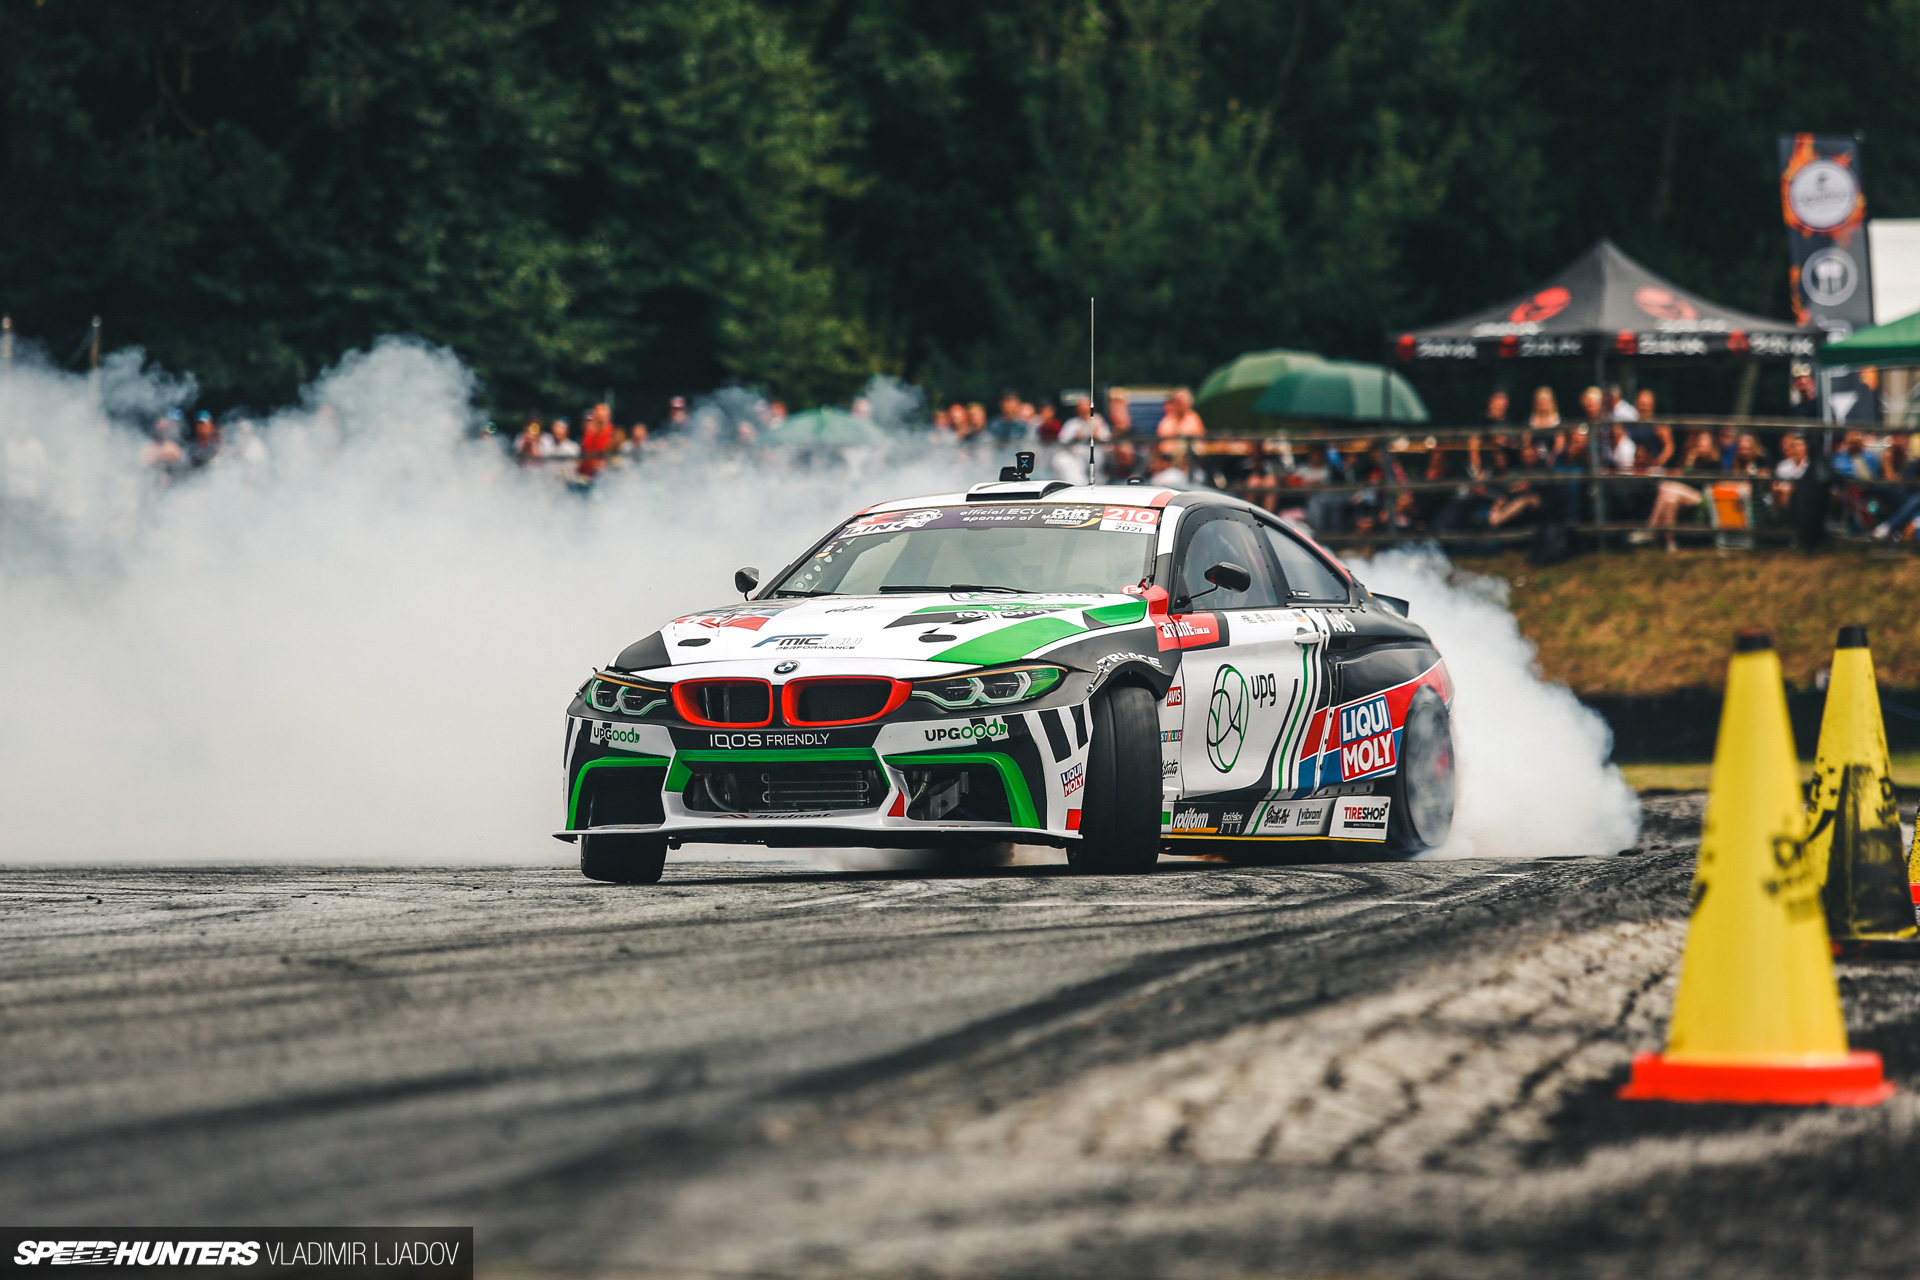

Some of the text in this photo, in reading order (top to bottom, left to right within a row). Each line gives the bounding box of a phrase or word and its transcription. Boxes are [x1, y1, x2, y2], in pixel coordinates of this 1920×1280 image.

[959, 508, 1003, 516] official
[962, 514, 1035, 523] sponsor of
[1103, 508, 1156, 523] 210
[1114, 525, 1143, 533] 2021
[1325, 614, 1356, 633] AVIS
[1096, 652, 1163, 669] TRI-ACE
[1167, 689, 1181, 703] AVIS
[1250, 673, 1277, 709] upg
[1342, 700, 1389, 741] LIQUI
[709, 733, 830, 749] IQOS FRIENDLY
[1160, 730, 1182, 740] STYLUS
[1343, 733, 1392, 777] MOLY
[1061, 763, 1082, 784] LIQUI
[1064, 774, 1084, 796] MOLY
[1173, 807, 1209, 832] rotiform
[1301, 807, 1323, 820] vibrant
[1344, 807, 1386, 820] TIRESHOP
[1219, 823, 1241, 833] 210
